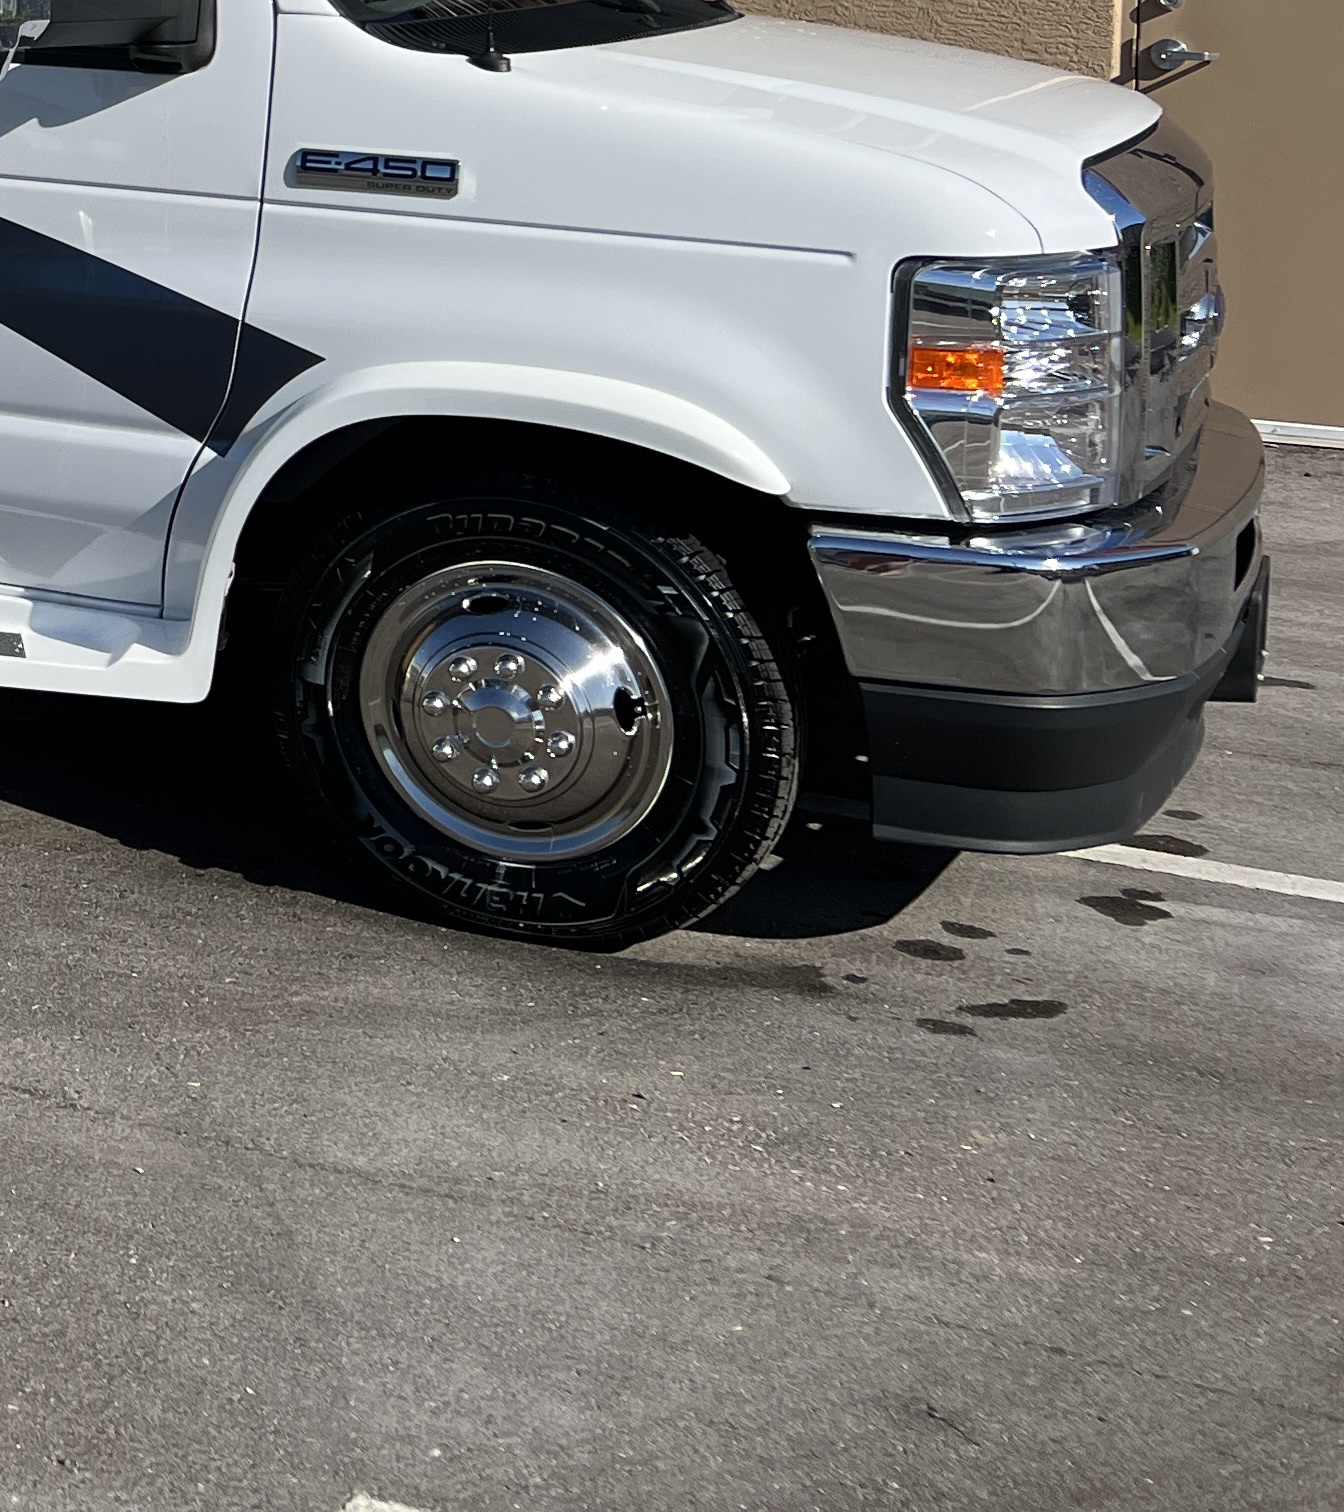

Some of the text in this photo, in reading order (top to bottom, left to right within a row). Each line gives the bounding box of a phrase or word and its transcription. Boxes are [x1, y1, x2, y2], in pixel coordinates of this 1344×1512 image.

[300, 150, 458, 183] E-450
[367, 181, 455, 195] SUPER DUTY
